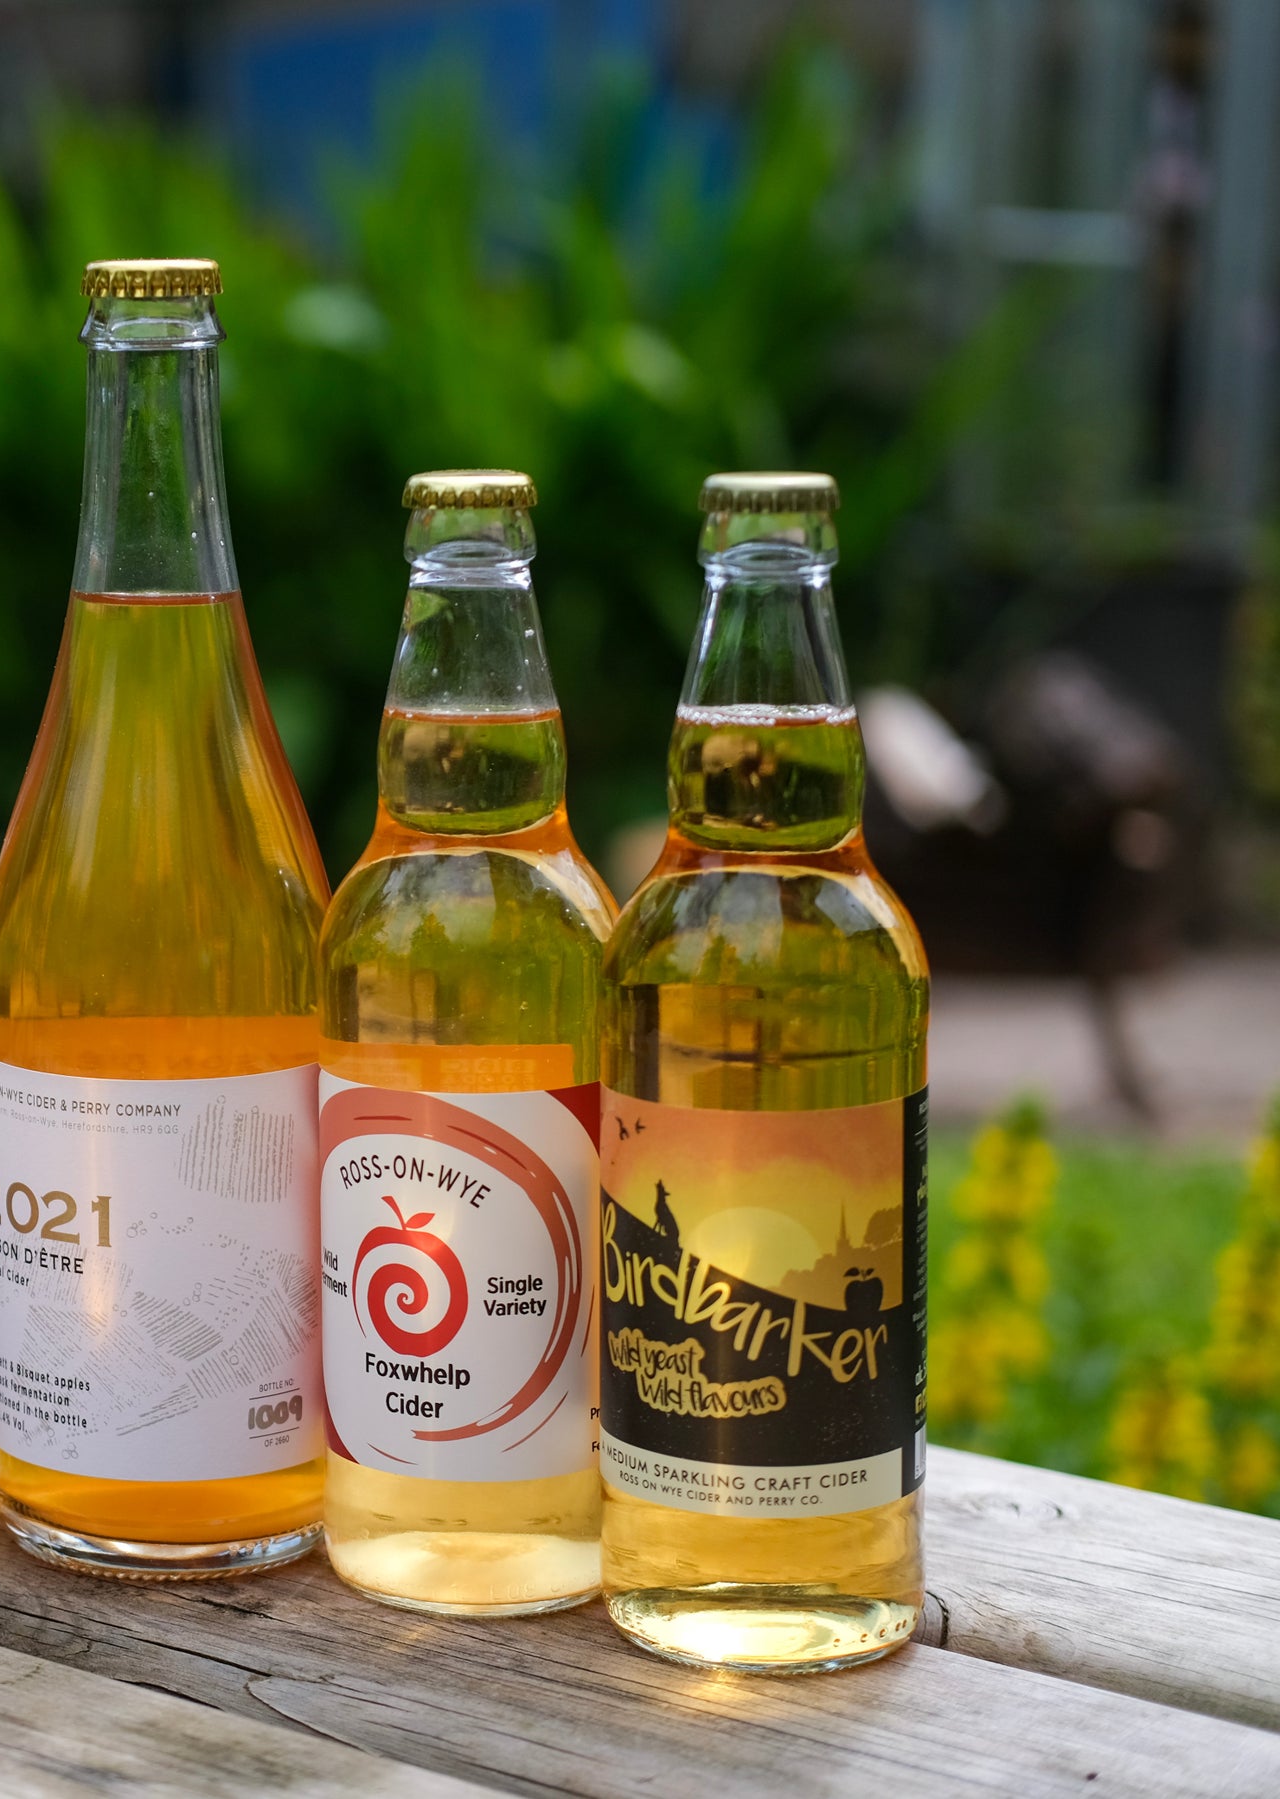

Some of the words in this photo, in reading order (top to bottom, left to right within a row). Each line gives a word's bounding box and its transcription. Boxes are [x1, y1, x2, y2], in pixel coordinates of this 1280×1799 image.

[26, 1093, 56, 1111] CIDER
[60, 1099, 67, 1112] &
[72, 1101, 110, 1116] PERRY
[116, 1104, 181, 1117] COMPANY
[62, 1121, 129, 1135] Herefordshire,
[133, 1125, 153, 1135] HR9
[339, 1154, 491, 1209] ROSS-ON-WYE
[25, 1247, 83, 1274] D'ÊTRE
[7, 1269, 29, 1287] Cider
[487, 1275, 543, 1297] Single
[601, 1199, 887, 1383] Birdbarker
[483, 1298, 547, 1317] Variety
[365, 1352, 471, 1390] Foxwhelp
[611, 1336, 642, 1367] Wild
[644, 1347, 698, 1379] yeast
[10, 1361, 14, 1373] &
[16, 1364, 50, 1384] Bisquet
[54, 1376, 90, 1392] apples
[259, 1380, 283, 1392] BOTTLE
[10, 1379, 70, 1407] fermentation
[385, 1391, 443, 1419] Cider
[640, 1374, 682, 1409] Wild
[685, 1381, 779, 1412] flavours
[13, 1417, 28, 1433] Vol.
[23, 1402, 31, 1416] in
[34, 1407, 49, 1421] the
[54, 1411, 87, 1428] bottle
[264, 1438, 273, 1447] OF
[607, 1446, 648, 1474] MEDIUM
[654, 1464, 745, 1490] SPARKLING
[754, 1476, 811, 1491] CRAFT
[820, 1469, 868, 1488] CIDER
[619, 1470, 639, 1486] ROSS
[642, 1479, 657, 1491] ON
[660, 1484, 682, 1498] WYE
[686, 1489, 721, 1503] CIDER
[725, 1495, 753, 1506] AND
[759, 1496, 795, 1506] PERRY
[800, 1495, 823, 1506] CO.
